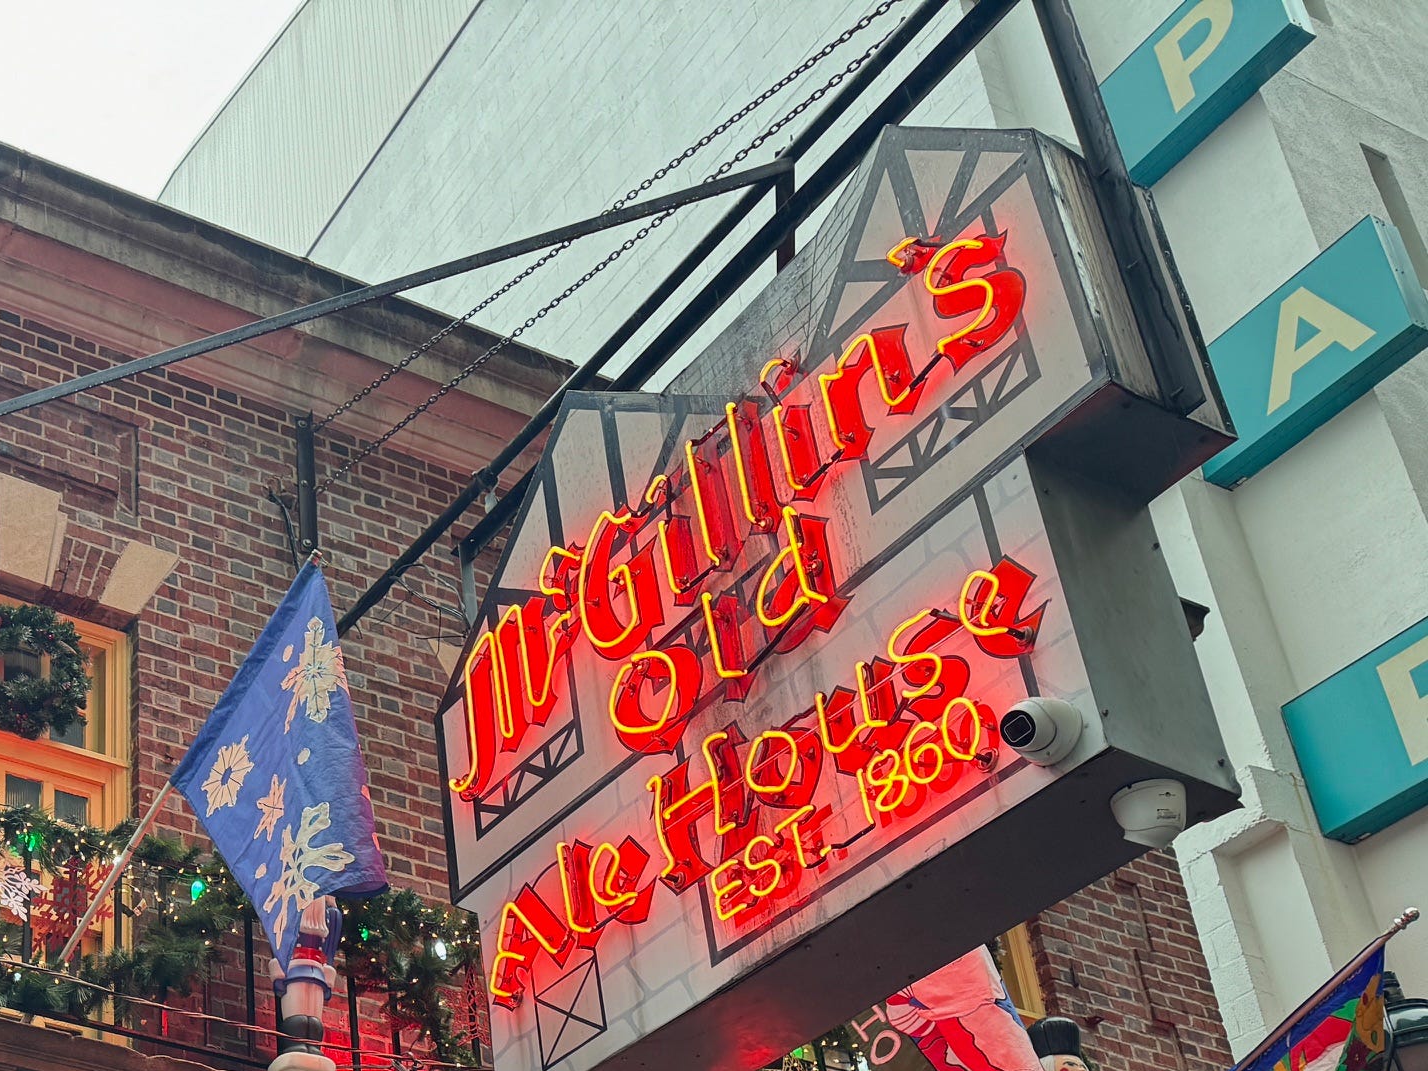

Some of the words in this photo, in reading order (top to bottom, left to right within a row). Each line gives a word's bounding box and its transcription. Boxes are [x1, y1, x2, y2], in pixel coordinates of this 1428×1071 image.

[450, 229, 1027, 801] McGillin's
[609, 506, 855, 754] Old
[490, 834, 655, 1009] Ale
[646, 554, 1052, 895] House
[711, 804, 848, 927] EST.
[857, 697, 1001, 830] 1860
